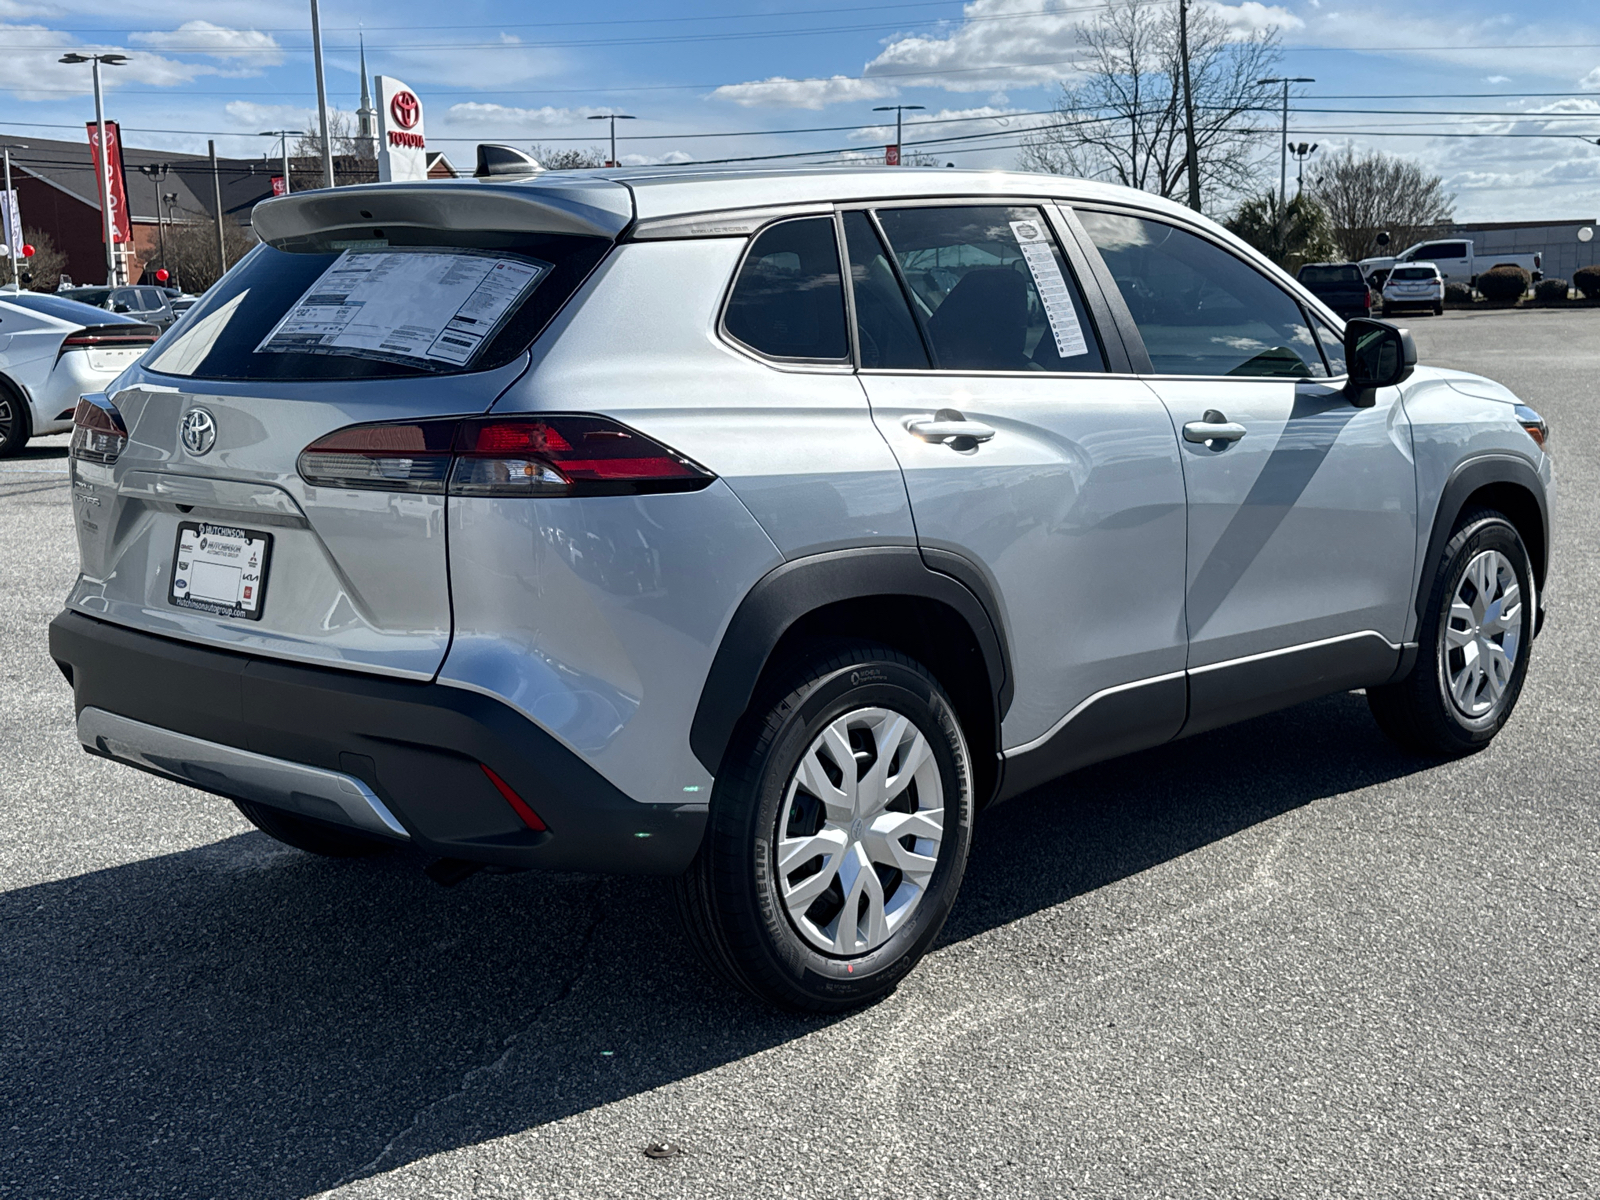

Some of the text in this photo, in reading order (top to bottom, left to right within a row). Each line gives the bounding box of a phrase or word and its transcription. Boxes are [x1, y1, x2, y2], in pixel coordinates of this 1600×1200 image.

[387, 130, 425, 150] TOYOTA
[205, 526, 246, 539] HUTCHINSON
[207, 541, 242, 553] HUTCHINSON
[176, 598, 246, 618] Hutchinsonautogroup.com
[949, 728, 968, 822] MICHELIN
[755, 844, 783, 943] MICHELIN
